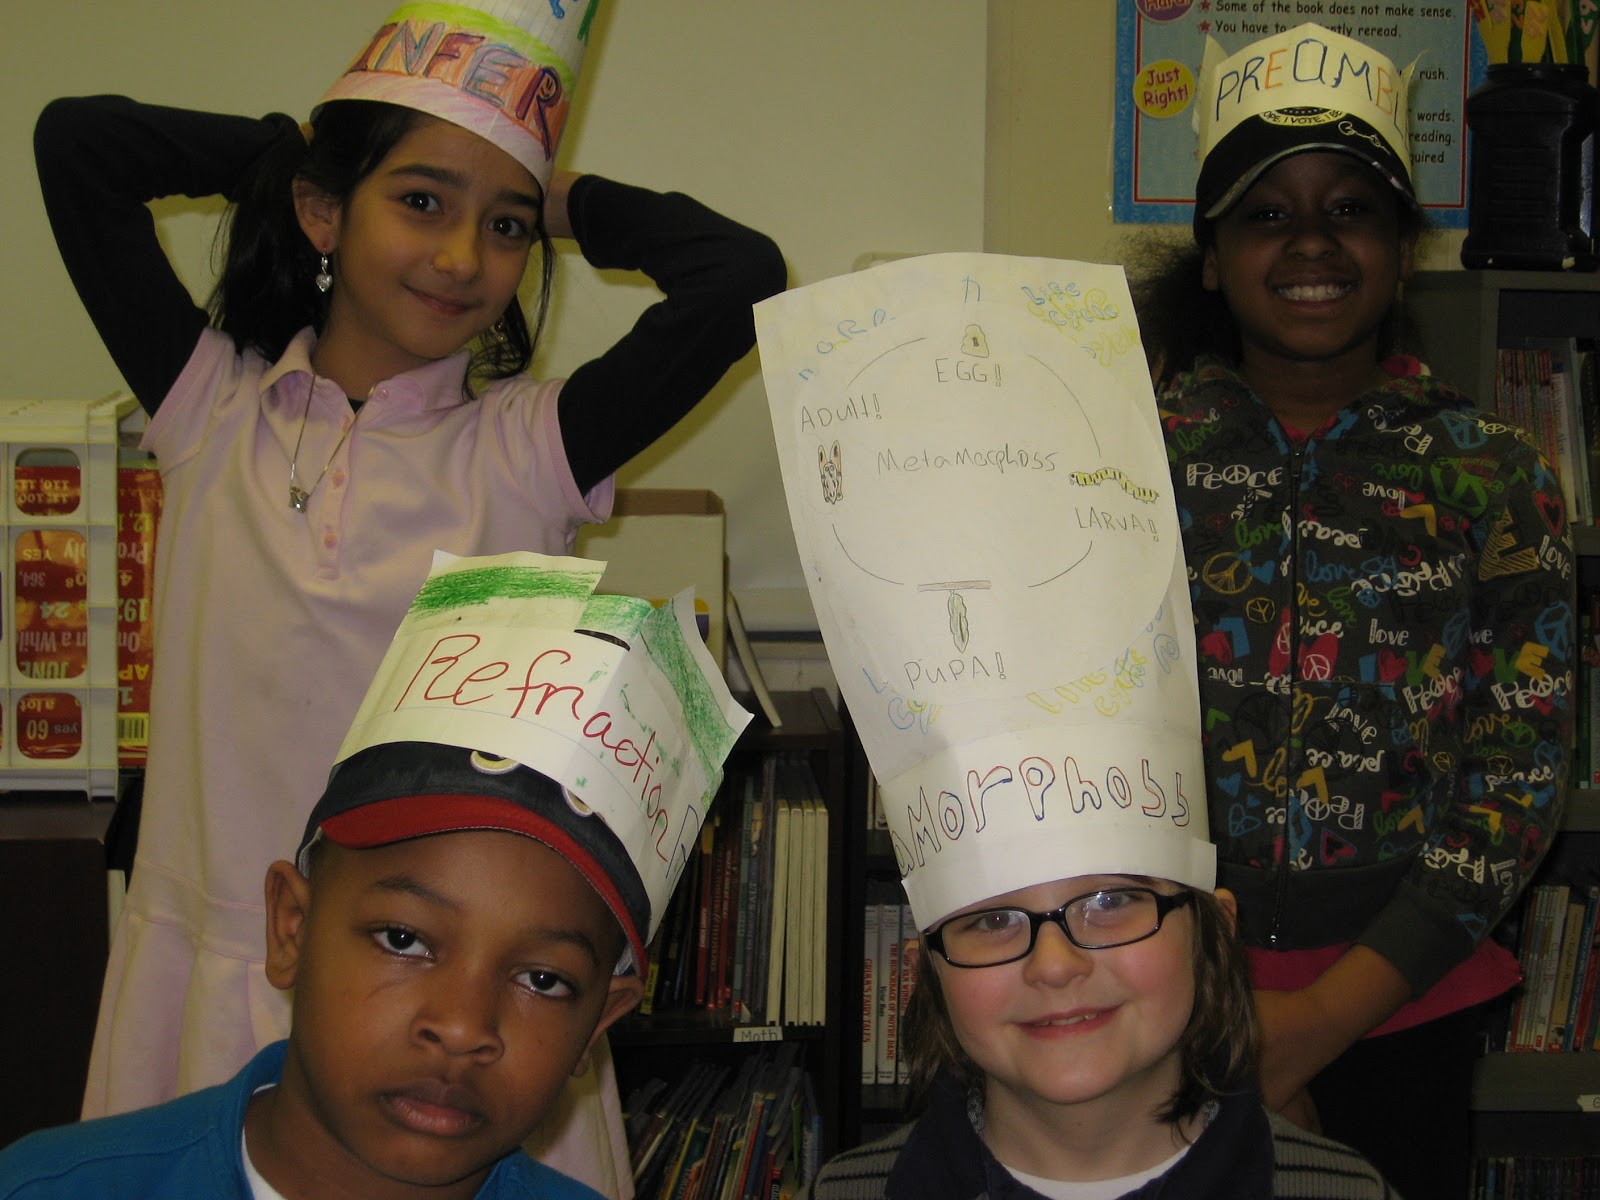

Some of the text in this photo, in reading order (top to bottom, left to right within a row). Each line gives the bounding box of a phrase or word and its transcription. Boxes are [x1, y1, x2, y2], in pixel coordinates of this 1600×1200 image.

[1215, 1, 1456, 18] Some of the book does not make sense.
[1215, 21, 1236, 33] You
[1242, 20, 1268, 33] have
[1274, 21, 1287, 33] to
[1358, 26, 1401, 37] reread.
[1147, 67, 1180, 87] Just
[1419, 67, 1449, 80] rush.
[344, 19, 562, 161] INFER
[1143, 84, 1189, 110] Right!
[1417, 110, 1455, 122] words.
[1411, 152, 1444, 166] quired
[935, 357, 1002, 387] EGG!
[1186, 462, 1284, 490] Peace
[22, 548, 52, 561] YES
[1539, 534, 1571, 580] love
[16, 631, 57, 653] Whil
[1368, 617, 1409, 647] love
[26, 719, 79, 741] yes 60
[393, 633, 669, 863] Refraction
[741, 1029, 778, 1042] Math
